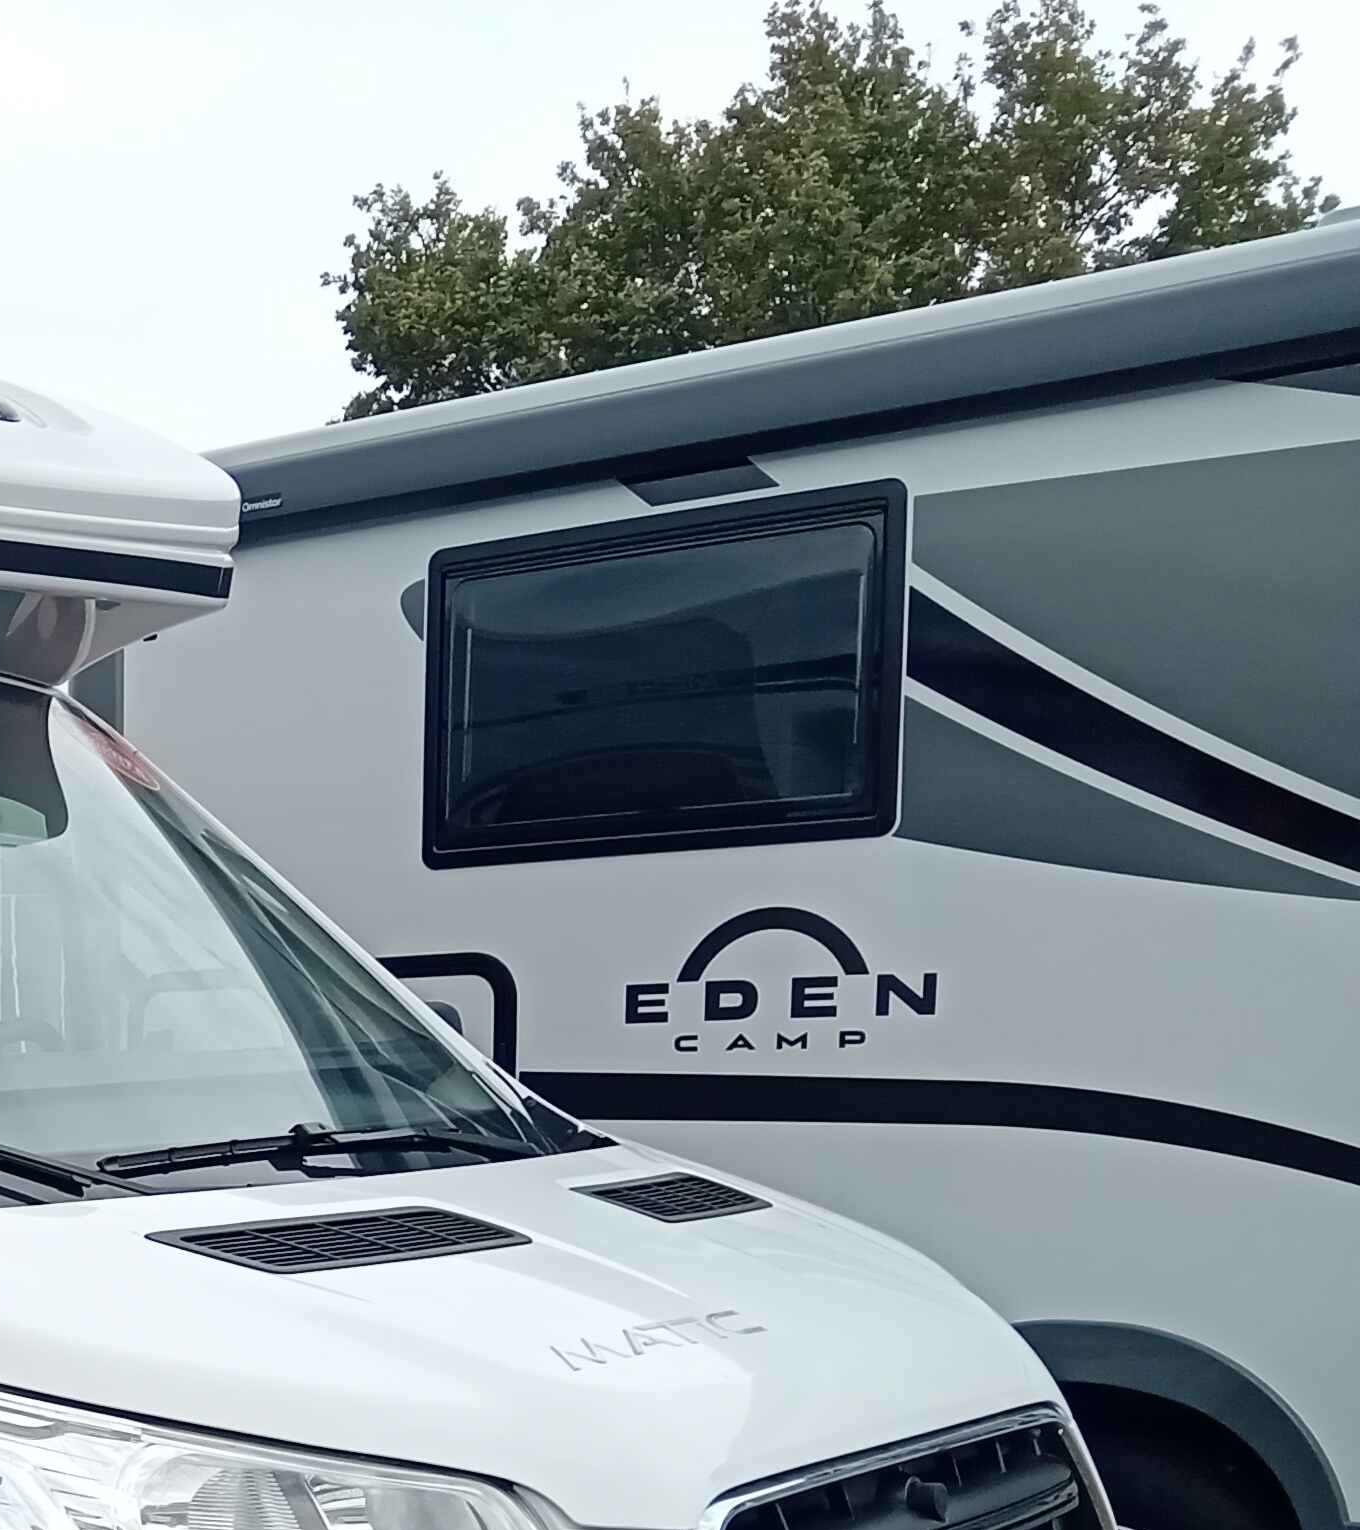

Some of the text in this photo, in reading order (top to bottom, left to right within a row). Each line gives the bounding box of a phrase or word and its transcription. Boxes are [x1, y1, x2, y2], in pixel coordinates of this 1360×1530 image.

[624, 972, 938, 1024] EDEN
[673, 1030, 867, 1053] CAMP
[548, 1309, 768, 1372] MATIC
